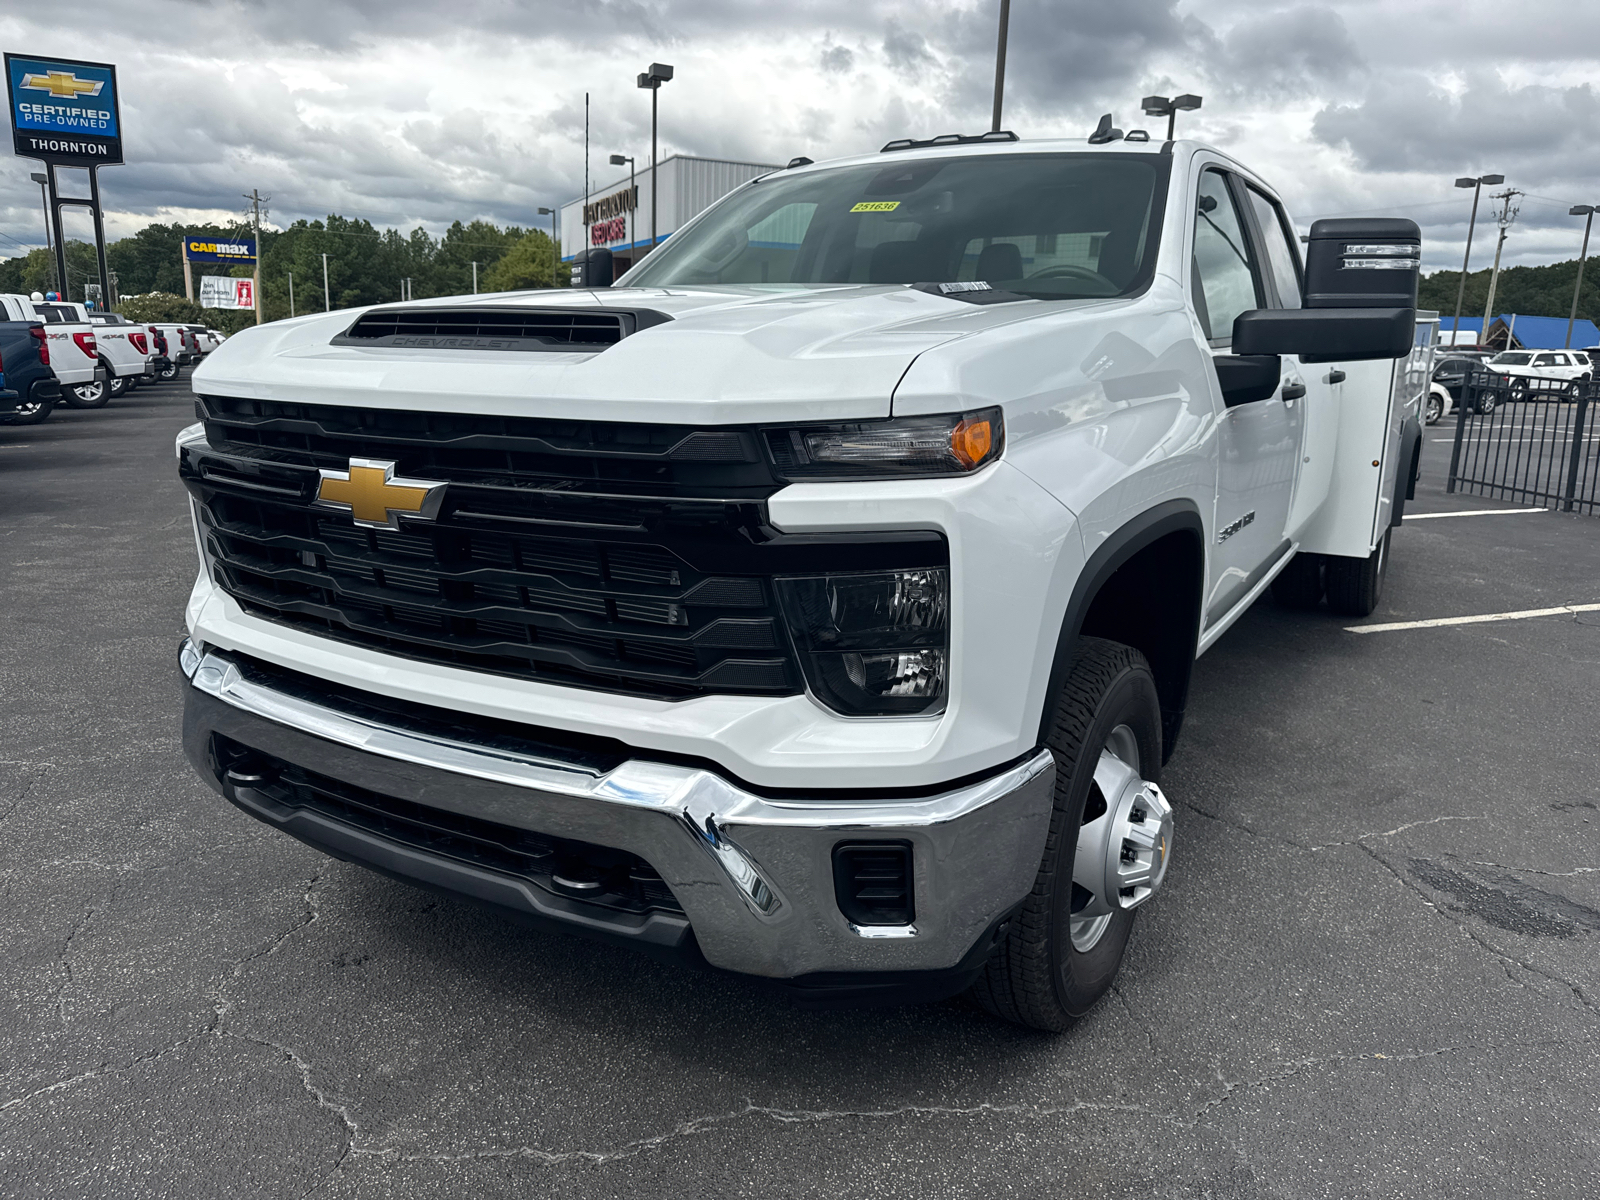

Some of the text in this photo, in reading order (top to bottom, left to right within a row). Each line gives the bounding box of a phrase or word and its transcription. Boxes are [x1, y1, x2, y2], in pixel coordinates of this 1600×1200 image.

[19, 103, 111, 120] CERTIFIED
[24, 113, 107, 129] PRE-OWNED
[29, 138, 107, 155] THORNTON
[606, 216, 625, 241] CARS
[391, 337, 520, 349] CHEVROLET
